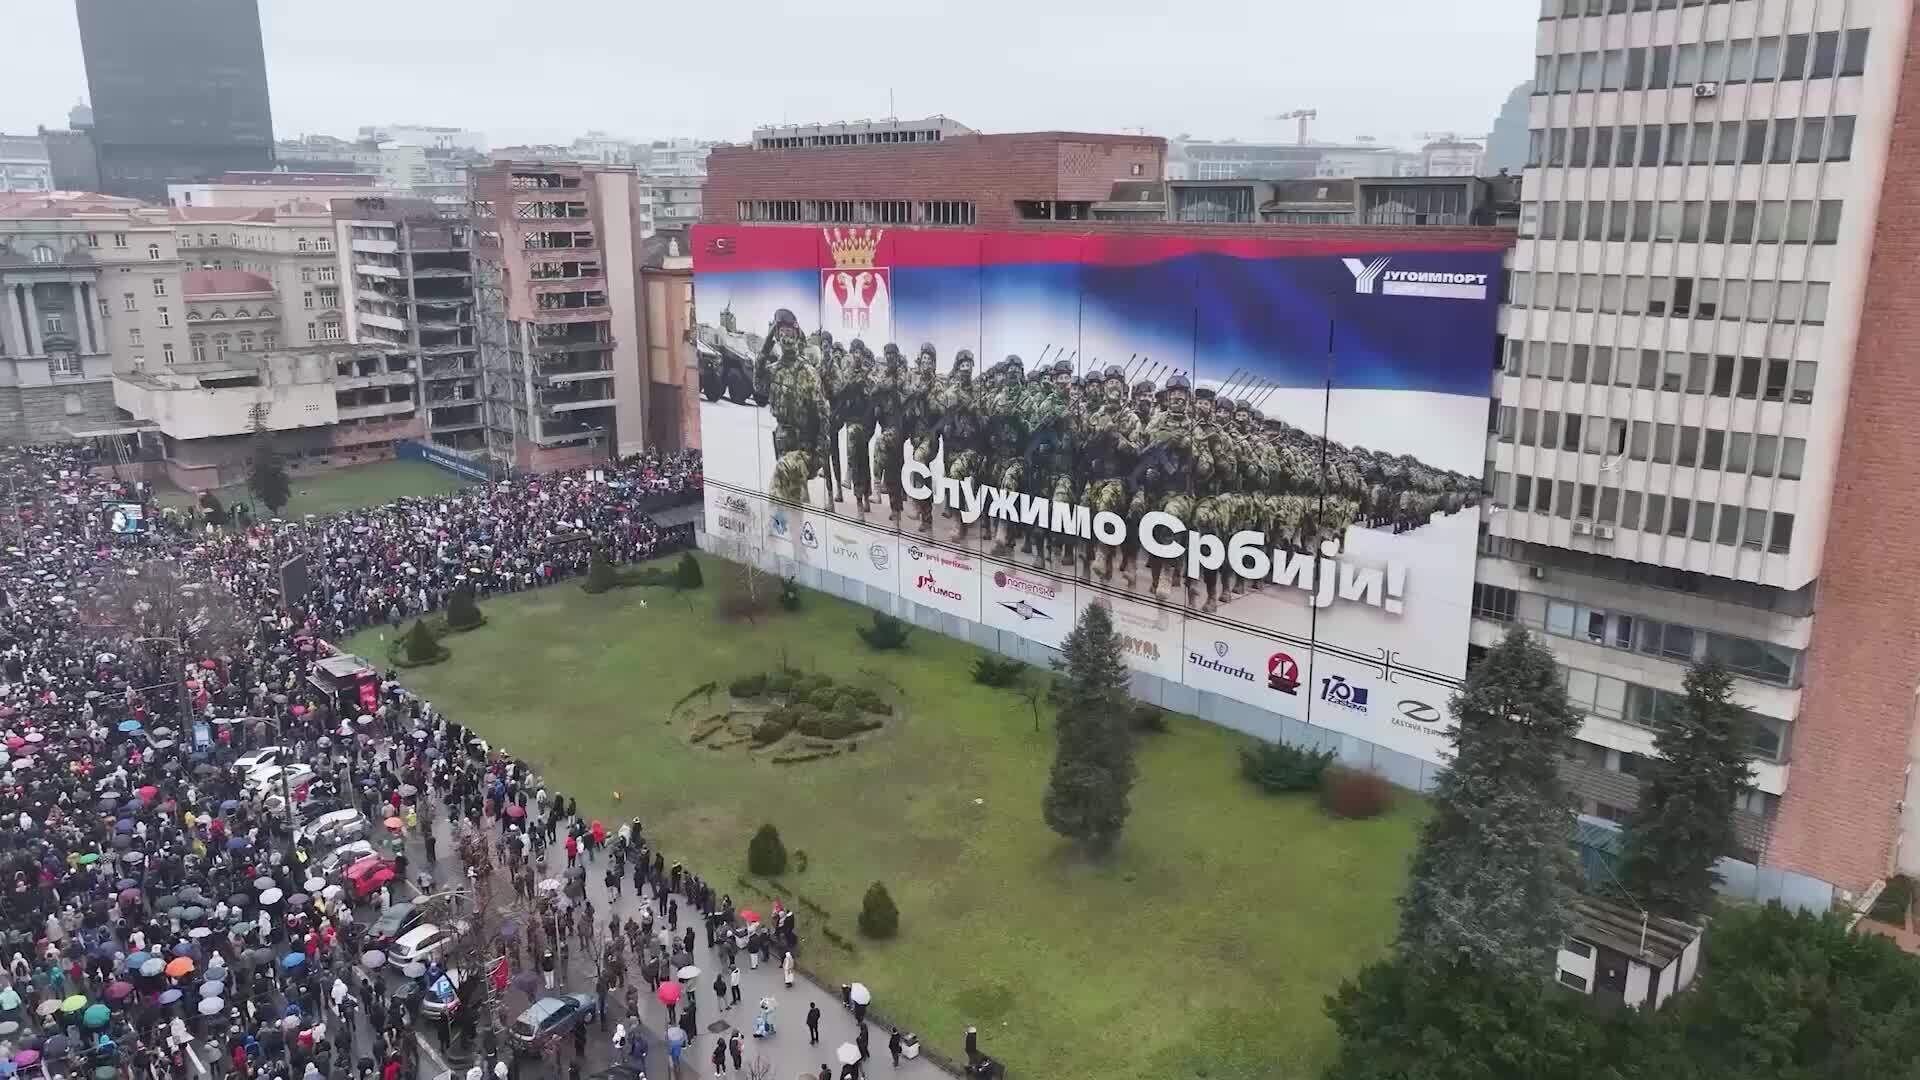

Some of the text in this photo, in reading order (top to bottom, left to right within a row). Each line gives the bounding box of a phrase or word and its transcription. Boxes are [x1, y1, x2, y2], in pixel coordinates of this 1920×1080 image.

[1138, 510, 1407, 615] Србији!
[927, 584, 962, 601] YUMCO
[1006, 577, 1056, 599] namenska
[1189, 652, 1255, 682] Sloboda
[1328, 694, 1368, 713] Zastava
